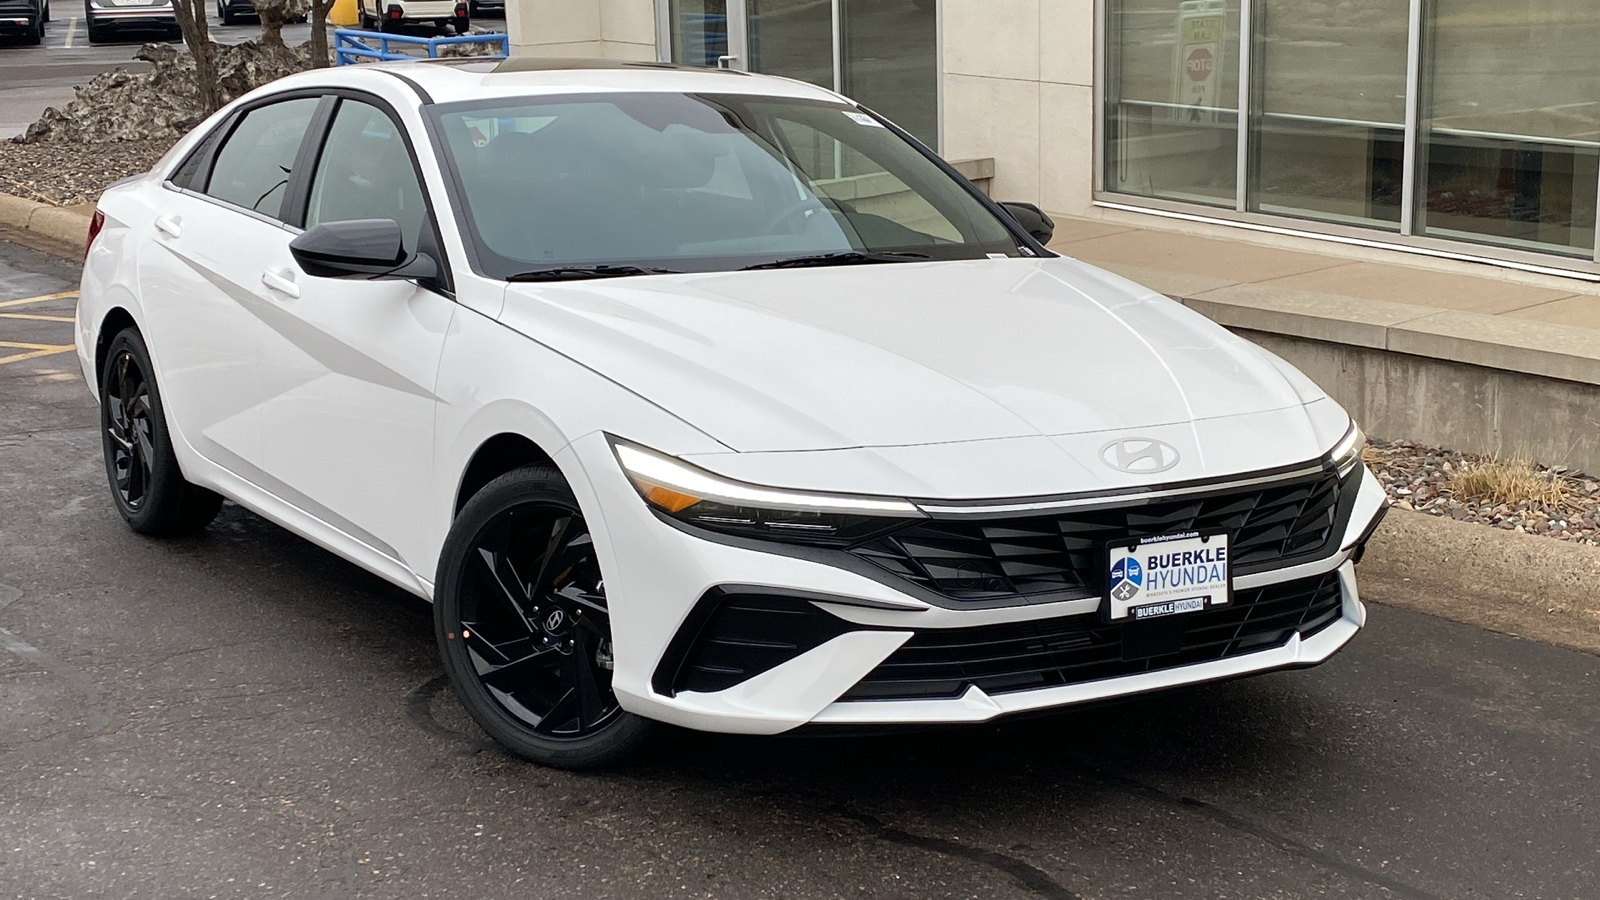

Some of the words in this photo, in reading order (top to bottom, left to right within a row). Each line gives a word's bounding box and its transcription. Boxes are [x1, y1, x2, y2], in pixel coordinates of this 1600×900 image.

[1140, 532, 1199, 544] buerklehyundai.com
[1147, 547, 1226, 570] BUERKLE
[1146, 563, 1226, 591] HYUNDAI
[1137, 604, 1174, 617] BUERKLE
[1175, 600, 1202, 611] HYUNDAI
